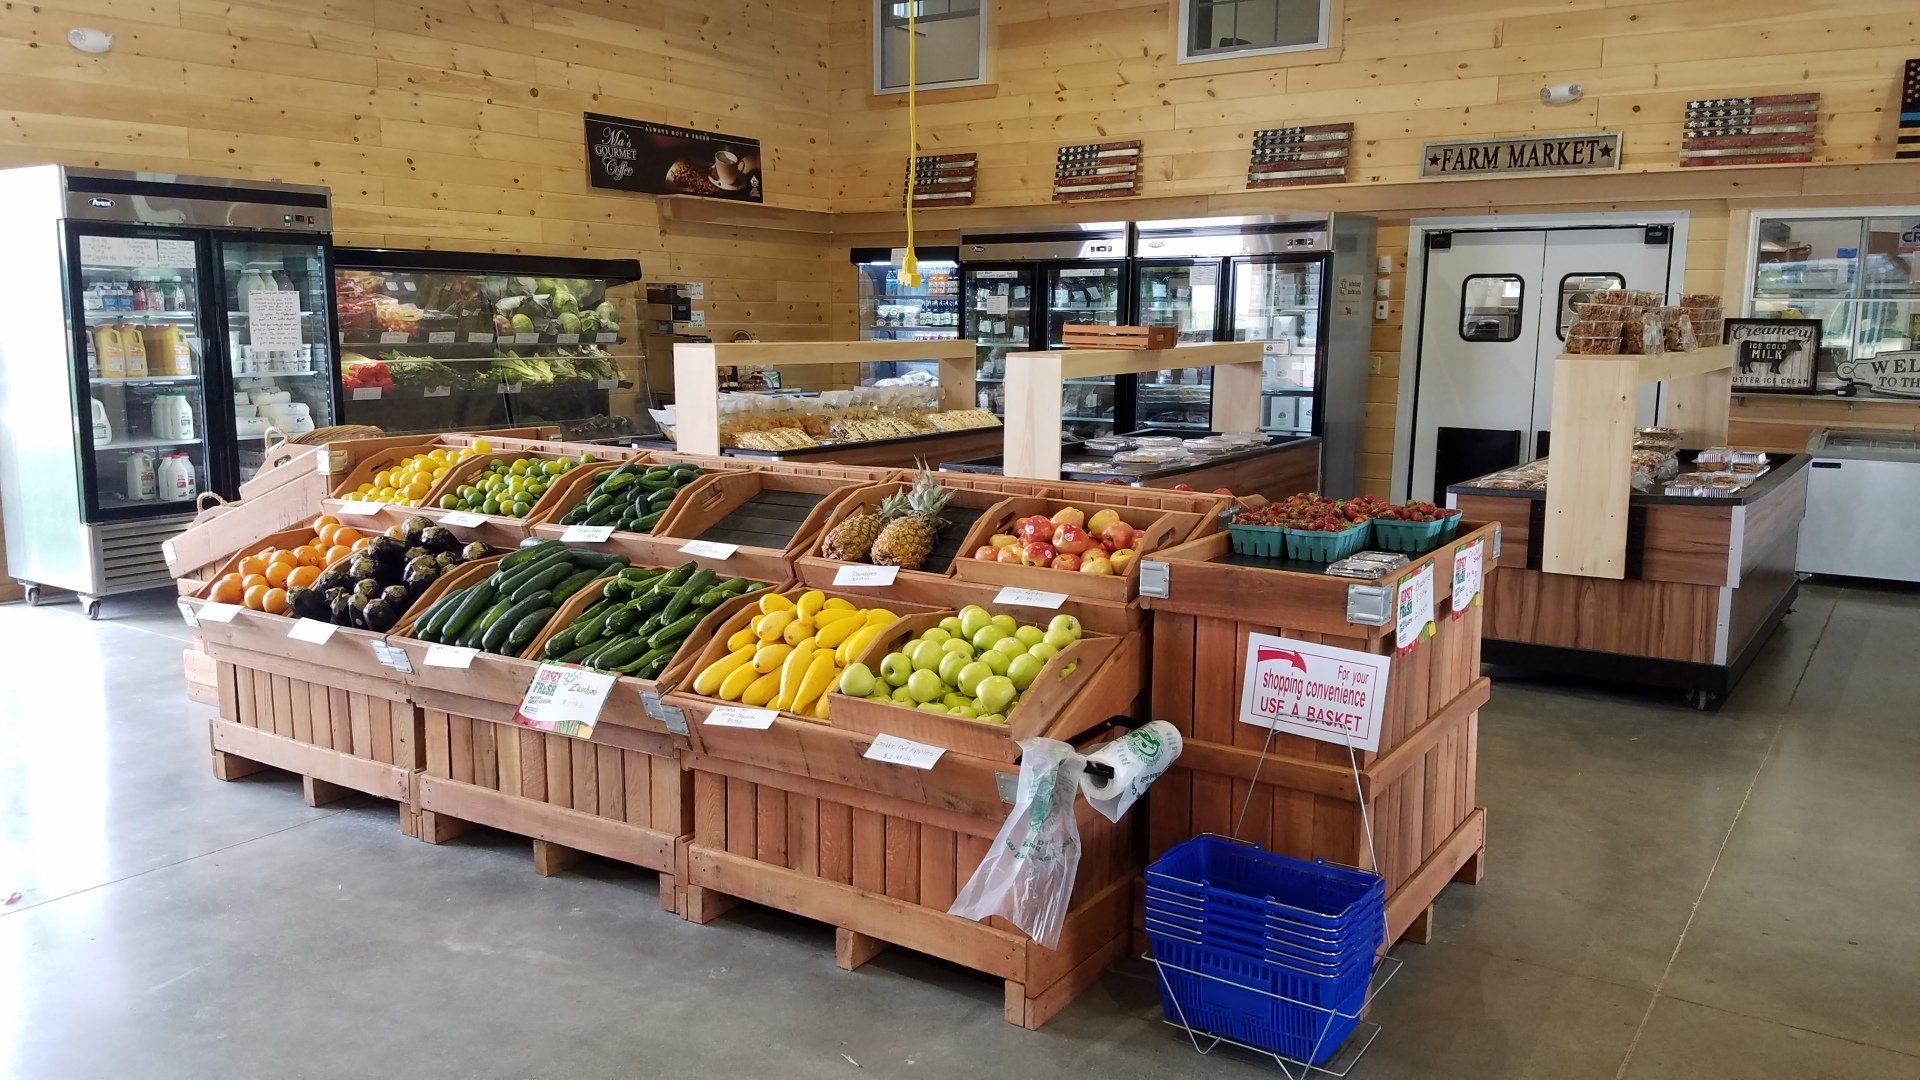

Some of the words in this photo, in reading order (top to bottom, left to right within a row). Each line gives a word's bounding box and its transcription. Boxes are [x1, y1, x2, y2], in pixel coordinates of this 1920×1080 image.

[601, 126, 632, 148] Ma's
[644, 126, 668, 135] ALWAYS
[595, 145, 637, 160] GOURMET
[1440, 145, 1501, 172] FARM
[1507, 139, 1600, 168] MARKET
[602, 156, 634, 181] Coffee
[1731, 323, 1815, 341] Creamery
[1749, 342, 1763, 350] ICE
[1765, 342, 1788, 351] COLD
[1751, 349, 1784, 360] MILK
[1732, 376, 1760, 384] UTTER
[1763, 376, 1778, 385] ICE
[1780, 377, 1809, 386] CREAM
[1878, 376, 1898, 388] TO
[1337, 665, 1351, 682] For
[1352, 672, 1369, 686] your
[1262, 668, 1304, 701] shopping
[1306, 679, 1366, 708] convenience
[1260, 695, 1285, 714] USE
[1290, 703, 1300, 719] A
[1306, 706, 1362, 732] BASKET
